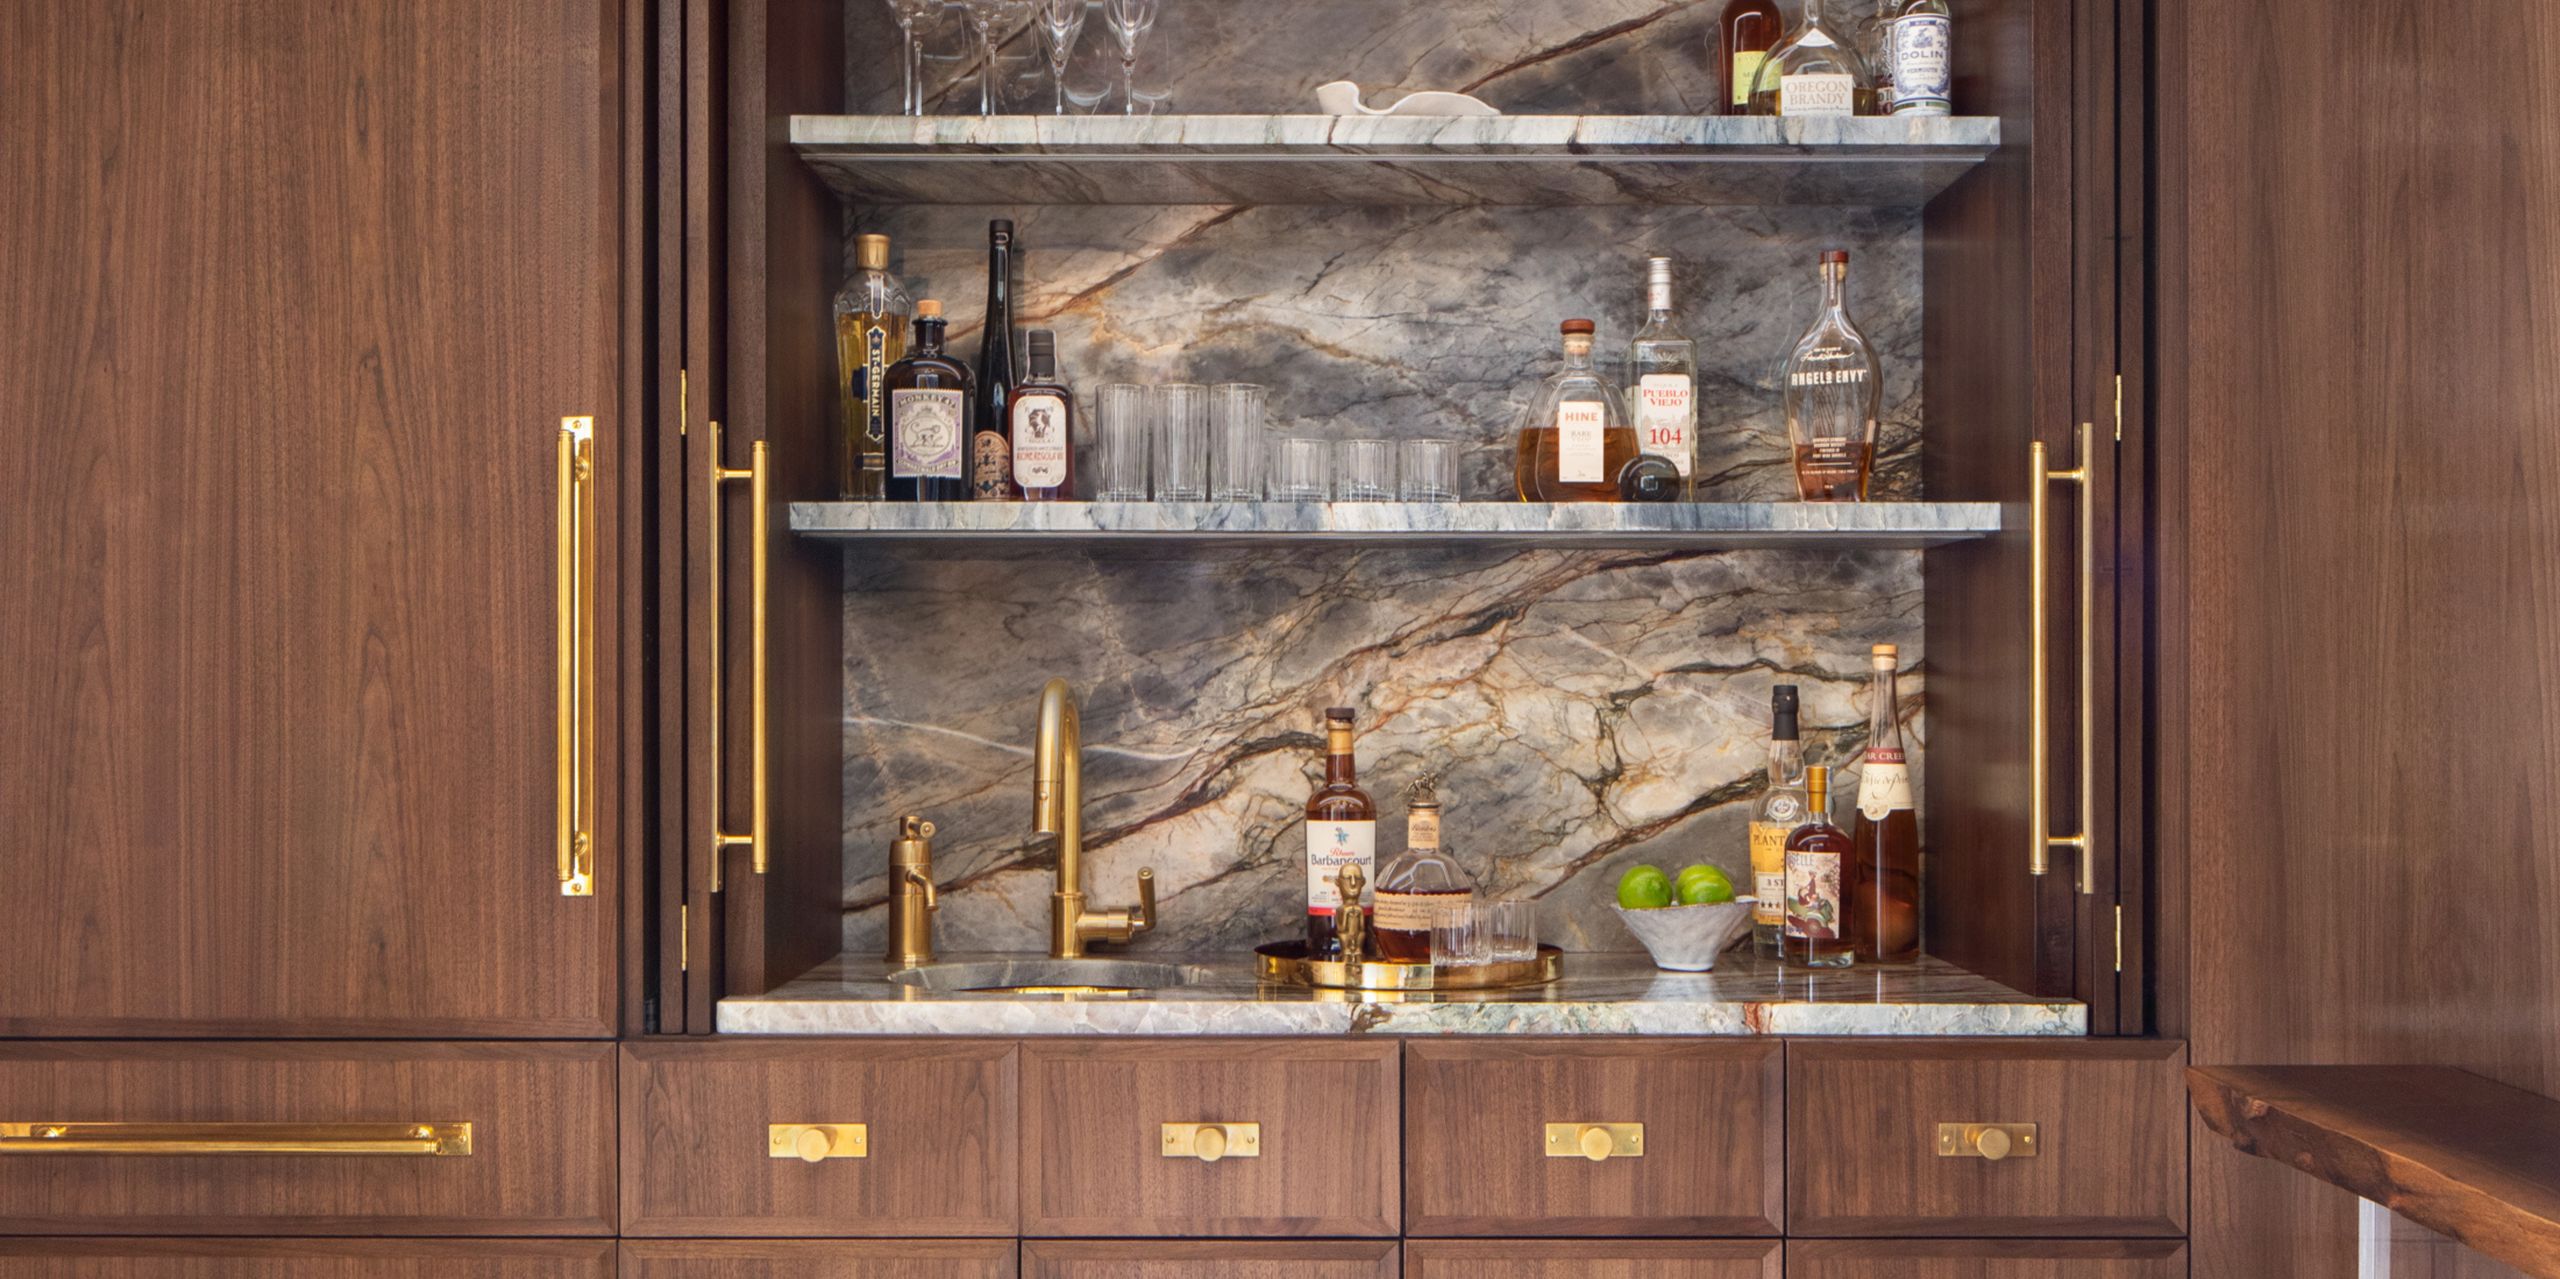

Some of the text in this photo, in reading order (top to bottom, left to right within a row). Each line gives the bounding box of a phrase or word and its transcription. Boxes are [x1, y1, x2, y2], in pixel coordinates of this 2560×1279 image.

[1901, 51, 1944, 60] DOLIN
[1786, 80, 1848, 94] OREGON
[1790, 93, 1845, 105] BRANDY
[1643, 389, 1688, 398] PUEBLO
[1649, 398, 1682, 407] VIEJO
[1565, 412, 1598, 422] HINE
[1649, 427, 1682, 445] 104
[1311, 854, 1372, 866] Barbancourt
